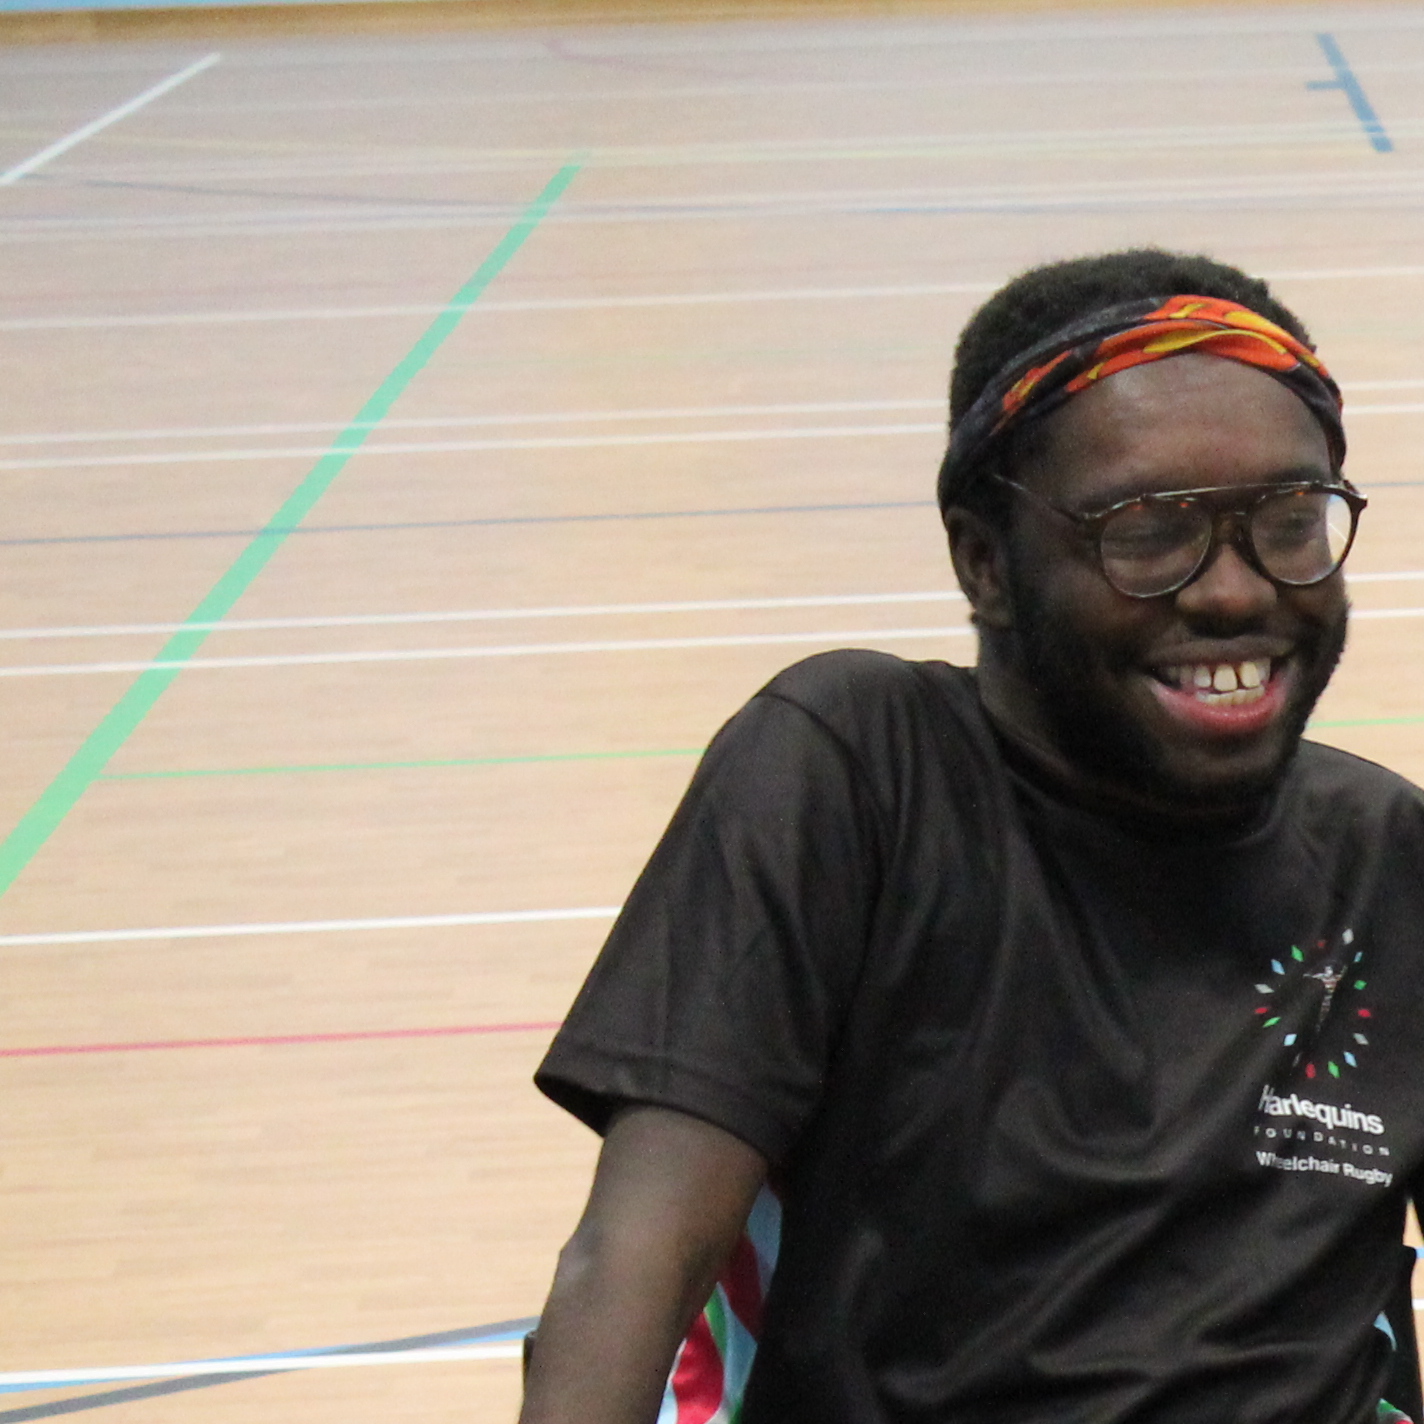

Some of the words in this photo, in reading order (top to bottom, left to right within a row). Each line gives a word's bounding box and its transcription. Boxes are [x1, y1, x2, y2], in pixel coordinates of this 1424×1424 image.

[1258, 1084, 1385, 1135] Harlequins
[1253, 1126, 1390, 1156] FOUNDATION
[1256, 1151, 1340, 1174] Wheelchair
[1342, 1163, 1393, 1188] Rugby
